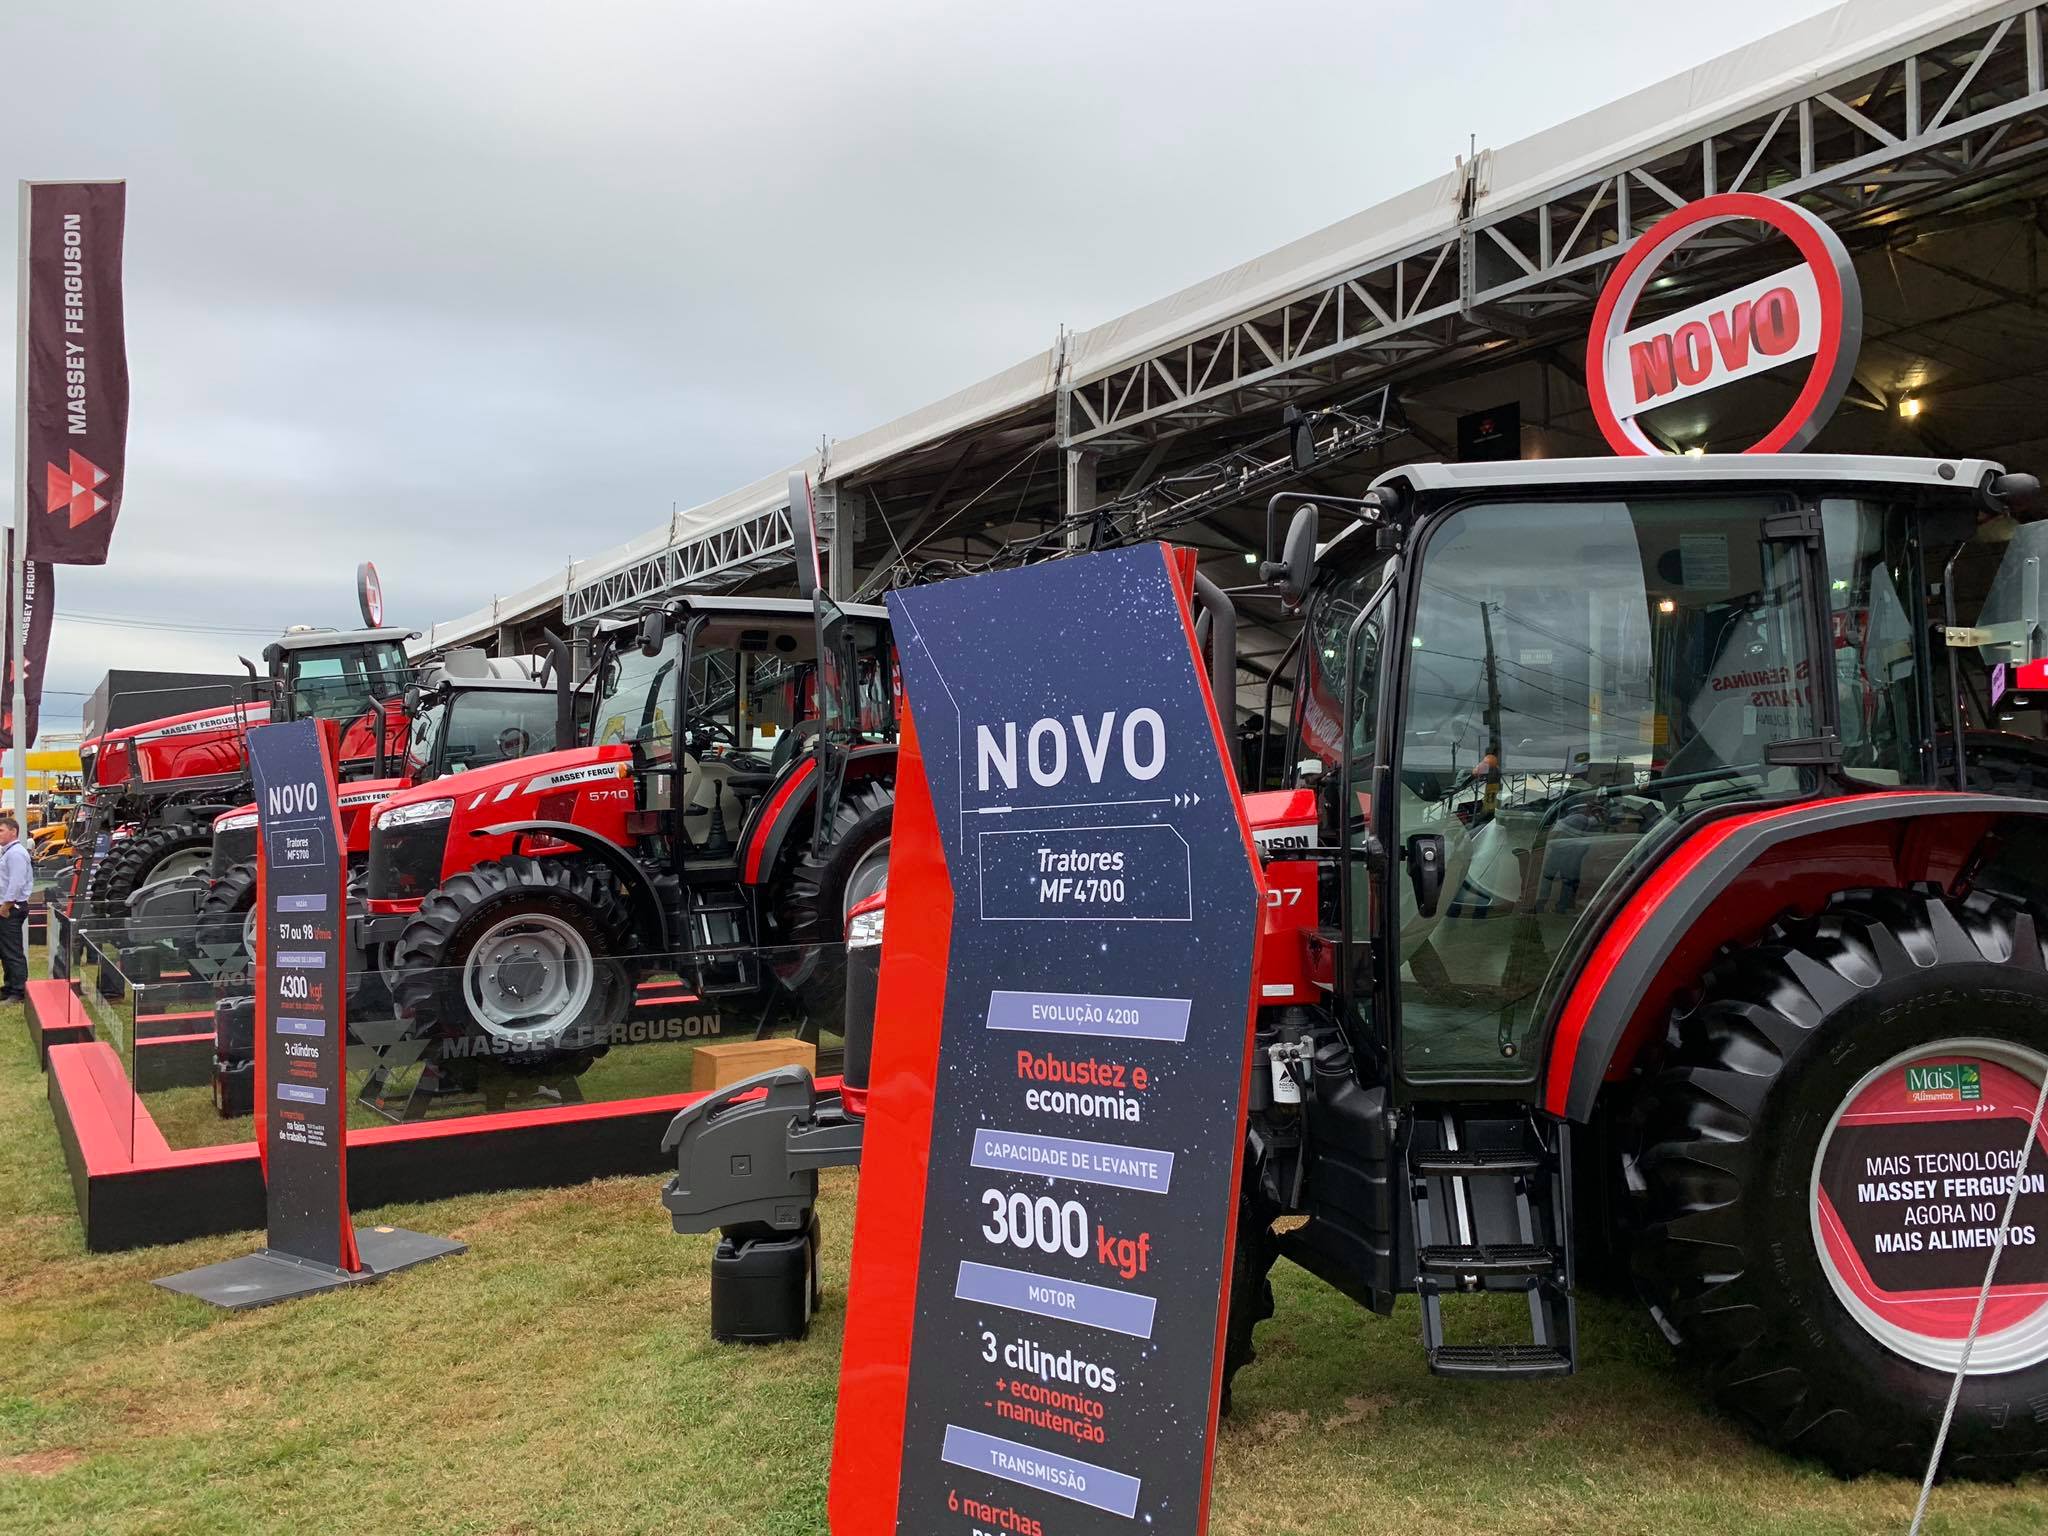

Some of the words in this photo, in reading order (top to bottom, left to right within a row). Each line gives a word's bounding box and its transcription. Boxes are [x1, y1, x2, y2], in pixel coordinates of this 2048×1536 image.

[64, 213, 83, 336] FERGUSON
[1630, 286, 1801, 405] NOVO
[65, 341, 87, 436] MASSEY
[161, 722, 198, 736] MASSEY
[976, 707, 1167, 792] NOVO
[551, 771, 586, 784] MASSEY
[587, 766, 616, 777] FERGU
[269, 782, 318, 816] NOVO
[341, 795, 371, 804] MASSEY
[589, 789, 629, 801] 5710
[286, 837, 309, 848] Tratores
[1256, 835, 1309, 849] USON
[1038, 848, 1124, 873] Tratores
[1040, 878, 1125, 904] MF4700
[279, 923, 290, 940] 57
[290, 927, 302, 940] ou
[303, 924, 313, 940] 98
[280, 975, 308, 999] 4300
[1032, 1003, 1103, 1026] EVOLUÇÃO
[1106, 1007, 1139, 1025] 4200
[284, 1042, 290, 1056] 3
[442, 1028, 566, 1059] MASSEY
[577, 1015, 721, 1047] FERGUSON
[1017, 1050, 1126, 1088] Robustez
[1131, 1067, 1148, 1089] e
[1909, 1067, 1954, 1091] Mais
[1025, 1086, 1141, 1123] economia
[1912, 1091, 1953, 1102] Alimentos
[984, 1141, 1068, 1167] CAPACIDADE
[1071, 1152, 1090, 1169] DE
[1093, 1155, 1158, 1179] LEVANTE
[1866, 1156, 1911, 1176] MAIS
[1914, 1149, 2028, 1174] TECNOLOGIA
[1858, 1180, 1937, 1203] MASSEY
[1944, 1174, 2045, 1200] FERGUSON
[1904, 1204, 1965, 1226] AGORA
[1971, 1202, 1996, 1222] NO
[981, 1187, 1089, 1258] 3000
[1097, 1225, 1151, 1280] kgf
[1875, 1231, 1923, 1253] MAIS
[1928, 1225, 2036, 1251] ALIMENTOS
[1028, 1285, 1076, 1310] MOTOR
[981, 1331, 997, 1363] 3
[1004, 1337, 1117, 1393] cilindros
[997, 1399, 1105, 1445] manutenção
[990, 1450, 1087, 1492] TRANSMISSÃO
[947, 1489, 959, 1512] 6
[963, 1498, 1043, 1536] marchas
